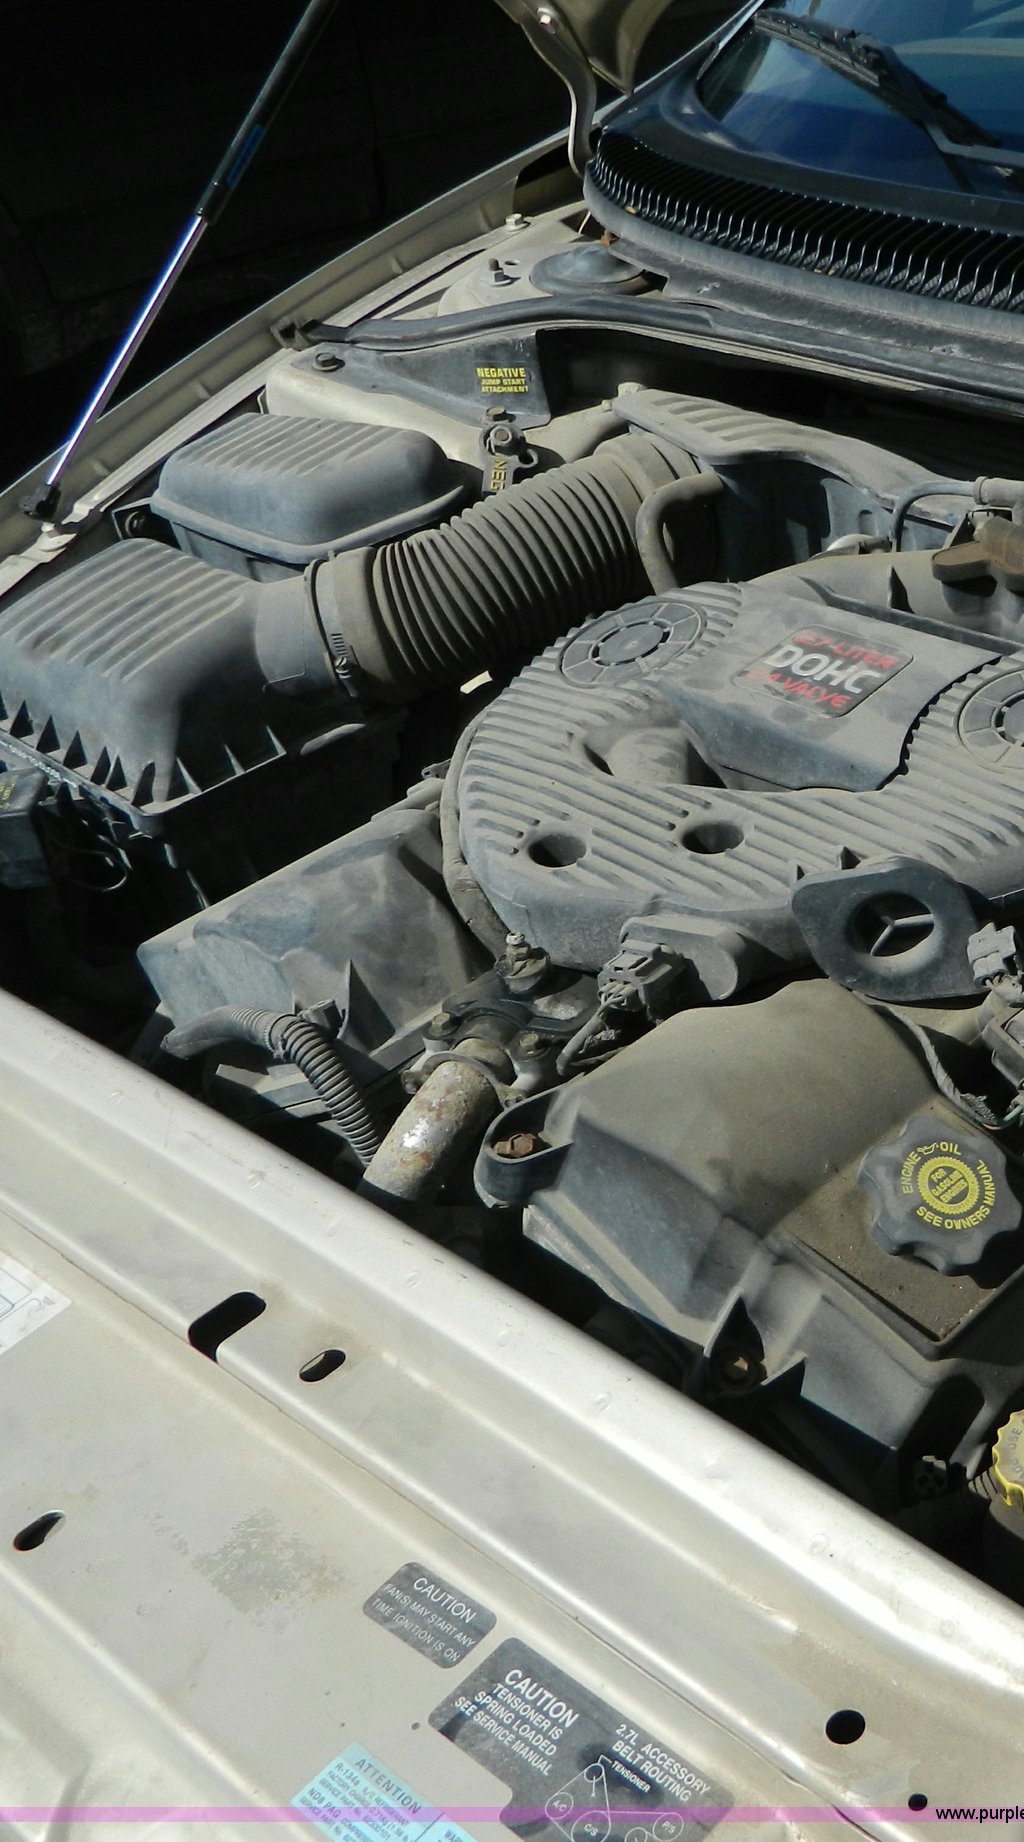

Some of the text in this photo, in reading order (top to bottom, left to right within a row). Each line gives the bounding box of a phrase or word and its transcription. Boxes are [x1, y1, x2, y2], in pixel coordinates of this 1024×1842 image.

[477, 368, 526, 378] NEGATIVE
[764, 644, 881, 694] DOHC
[902, 1141, 962, 1194] ENGINE OIL
[930, 1168, 947, 1183] FOR
[931, 1170, 963, 1197] GASOLINE
[916, 1159, 996, 1230] SEE OWNERS MANUAL
[1006, 1427, 1023, 1450] USE
[383, 1583, 476, 1648] FAN(S) MAY START ANY
[413, 1578, 477, 1623] CAUTION
[371, 1598, 460, 1662] TIME IGNITION IS ON
[474, 1691, 557, 1756] SPRING LOADED
[492, 1683, 563, 1740] TENSIONER IS
[504, 1669, 579, 1728] CAUTION
[454, 1696, 552, 1776] SEE SERVICE MANUAL
[615, 1724, 711, 1796] 2.7L ACCESSORY
[354, 1758, 422, 1815] ATTENTION
[611, 1740, 692, 1802] BELT ROUTING
[611, 1760, 651, 1793] TENSIONER
[322, 1800, 342, 1819] PAG
[552, 1799, 567, 1812] A/C
[583, 1823, 599, 1837] C/S
[661, 1820, 676, 1834] P/S
